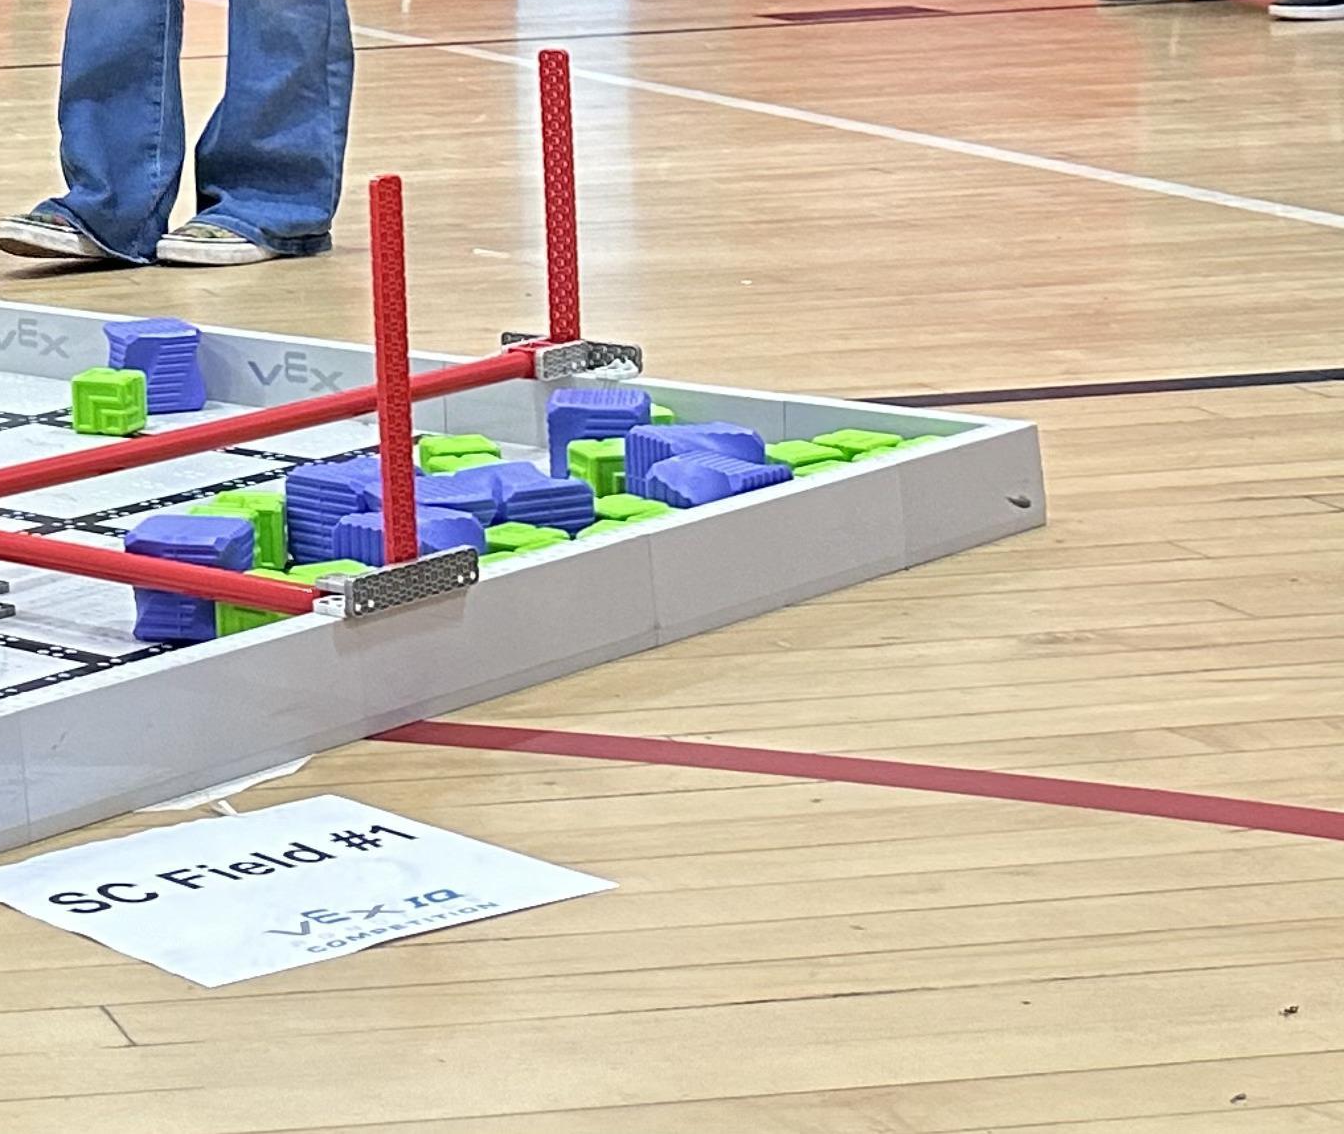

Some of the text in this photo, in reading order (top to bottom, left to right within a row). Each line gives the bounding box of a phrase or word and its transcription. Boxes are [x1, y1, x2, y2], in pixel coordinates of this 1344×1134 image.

[248, 351, 344, 391] VEX
[48, 824, 419, 914] SC Field #1
[265, 888, 465, 936] VEX IQ
[307, 901, 500, 953] COMPETITION
